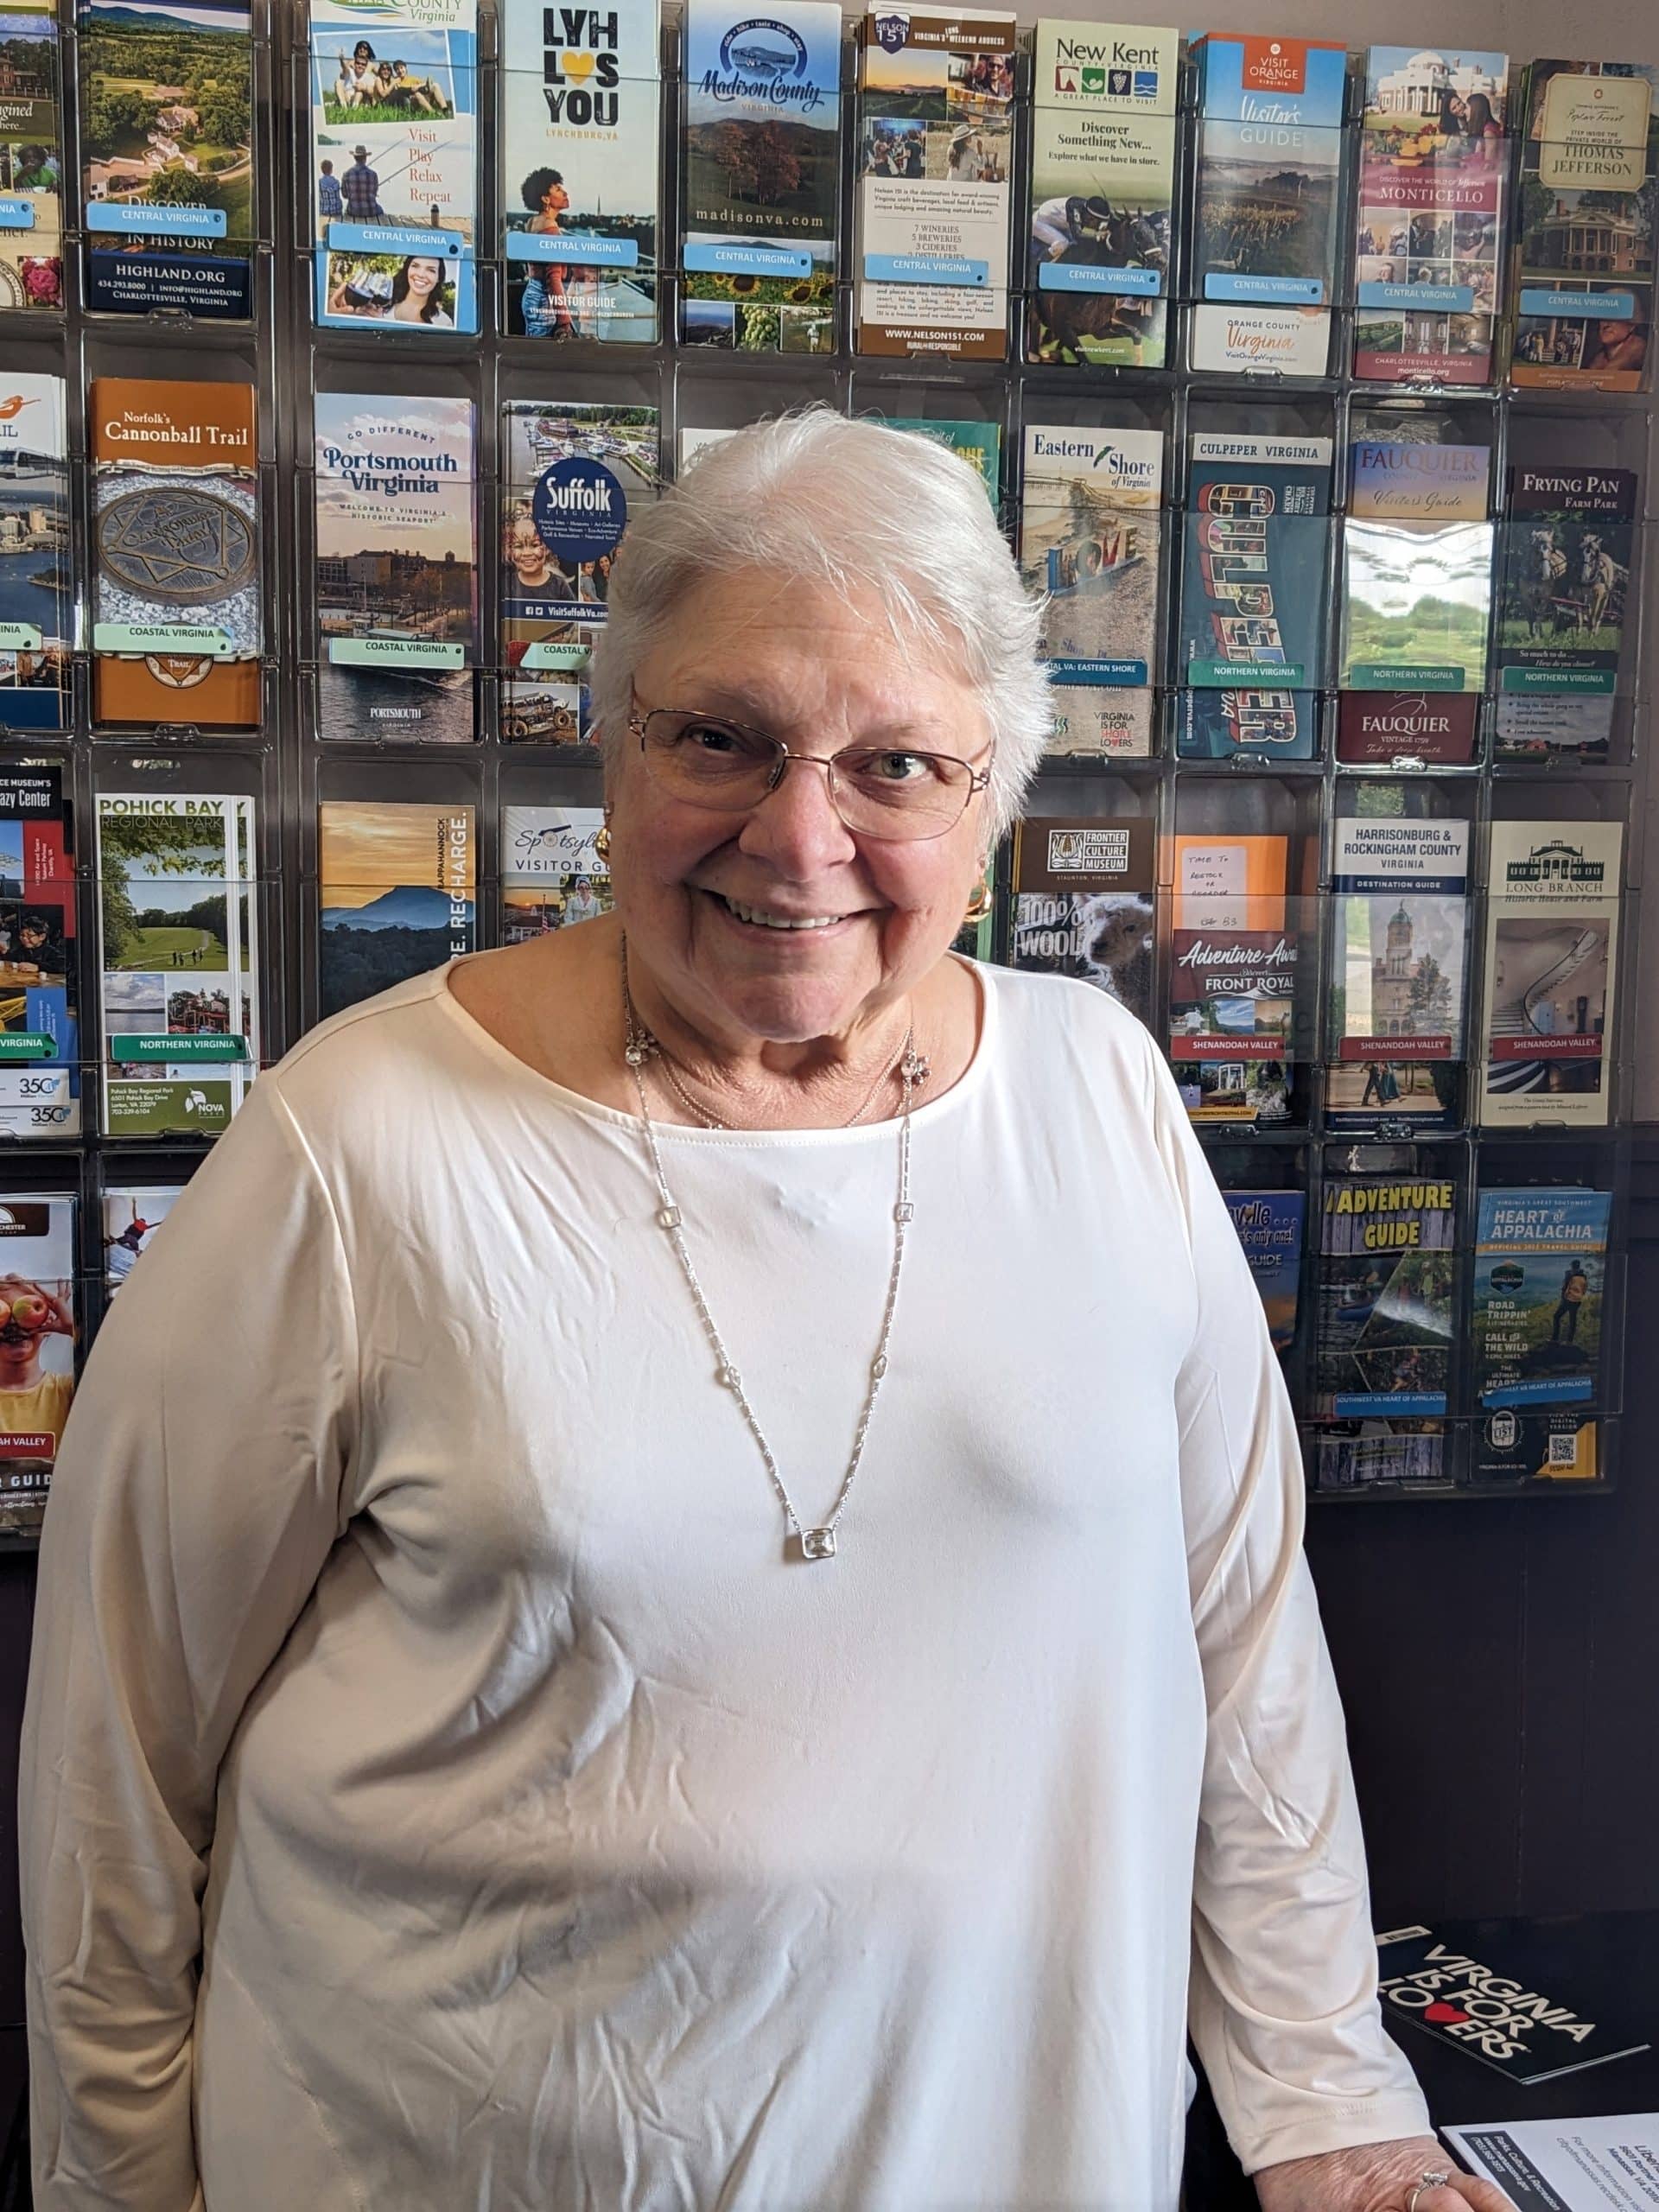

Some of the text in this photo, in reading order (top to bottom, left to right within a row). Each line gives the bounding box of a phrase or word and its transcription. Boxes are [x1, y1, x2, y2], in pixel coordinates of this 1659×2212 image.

[410, 9, 456, 24] Virginia
[543, 8, 618, 49] LYH
[876, 22, 909, 33] NELSON
[876, 30, 906, 42] 151
[1057, 38, 1160, 65] New Kent
[1260, 57, 1289, 68] VISIT
[1249, 66, 1299, 79] ORANGE
[698, 69, 825, 113] Madison County
[543, 89, 619, 126] YOU
[1240, 95, 1302, 125] Visitor's
[409, 128, 437, 143] Visit
[1081, 122, 1129, 135] Discover
[1058, 134, 1116, 149] Something
[1240, 128, 1302, 147] GUIDE
[409, 148, 435, 166] Play
[1048, 151, 1078, 162] Explore
[1079, 153, 1097, 162] what
[1110, 155, 1128, 164] have
[1562, 144, 1624, 160] THOMAS
[1552, 160, 1632, 175] JEFFERSON
[409, 168, 443, 183] Relax
[410, 188, 452, 206] Repeat
[1379, 187, 1484, 203] MONTICELLO
[122, 210, 210, 224] CENTRAL VIRGINIA
[696, 208, 824, 227] madisonva.com
[921, 225, 960, 234] WINERIES
[363, 231, 448, 245] CENTRAL VIRGINIA
[918, 234, 962, 244] BREWERIES
[539, 240, 621, 253] CENTRAL VIRGINIA
[715, 251, 796, 265] CENTRAL VIRGINIA
[893, 259, 971, 273] CENTRAL VIRGINIA
[116, 264, 226, 283] HIGHLAND.ORG
[1069, 270, 1146, 283] CENTRAL VIRGINIA
[1234, 280, 1308, 292] CENTRAL VIRGINIA
[1383, 287, 1458, 300] CENTRAL VIRGINIA
[548, 295, 616, 308] VISITOR GUIDE
[1548, 296, 1619, 308] CENTRAL VIRGINIA
[1227, 319, 1300, 331] ORANGE COUNTY
[885, 329, 985, 342] WWW.NELSON151.COM
[1226, 325, 1295, 355] Virginia
[1397, 366, 1450, 377] monticello.org
[124, 410, 171, 424] Norfolk's
[105, 421, 249, 446] Cannonball Trail
[347, 425, 435, 444] GO DIFFERENT
[1033, 434, 1155, 476] Eastern Shore
[1199, 442, 1319, 459] CULPEPER VIRGINIA
[323, 447, 458, 473] Portsmouth
[1361, 448, 1480, 474] FAUQUIER
[342, 469, 440, 497] Virginia
[1111, 476, 1152, 490] of Virginia
[1522, 474, 1619, 493] FRYING PAN
[546, 476, 612, 512] Suffolk
[1565, 497, 1618, 509] FARM PARK
[546, 509, 612, 518] VIRGINIA
[130, 626, 214, 639] COASTAL VIRGINIA
[365, 641, 448, 654] COASTAL VIRGINIA
[543, 645, 582, 654] COASTAL
[1077, 664, 1137, 673] EASTERN SHORE
[1213, 666, 1296, 677] NORTHERN VIRGINIA
[1373, 670, 1454, 680] NORTHERN VIRGINIA
[1525, 672, 1604, 683] NORTHERN VIRGINIA
[370, 707, 422, 719] PORTSMOUTH
[1094, 711, 1135, 721] VIRGINIA
[1101, 721, 1128, 729] IS FOR
[1362, 715, 1451, 735] FAUQUIER
[10, 779, 52, 787] MUSEUM'S
[19, 789, 52, 807] Center
[99, 799, 225, 815] POHICK BAY
[101, 815, 223, 830] REGIONAL PARK
[1086, 833, 1126, 843] FRONTIER
[1355, 829, 1452, 842] HARRISONBURG &
[436, 817, 446, 889] RAPPAHANNOCK
[1085, 846, 1125, 856] CULTURE
[1344, 843, 1462, 857] ROCKINGHAM COUNTY
[450, 811, 467, 930] RECHARGE.
[515, 859, 582, 873] VISITOR
[1085, 859, 1124, 869] MUSEUM
[1381, 859, 1425, 869] VIRGINIA
[1356, 880, 1441, 889] DESTINATION GUIDE
[1506, 882, 1603, 893] LONG BRANCH
[1020, 899, 1083, 927] 100%
[1020, 930, 1081, 957] WOOL
[1178, 939, 1266, 969] Adventure
[1205, 976, 1294, 991] FRONT ROYAL
[0, 1039, 43, 1047] VIRGINIA
[139, 1039, 235, 1049] NORTHERN VIRGINIA
[1360, 1040, 1445, 1050] SHENANDOAH VALLEY
[1513, 1039, 1596, 1050] SHENANDOAH VALLEY
[198, 1103, 225, 1113] NOVA
[1337, 1184, 1454, 1214] ADVENTURE
[1494, 1210, 1549, 1224] HEART
[1363, 1221, 1421, 1249] GUIDE
[1491, 1224, 1592, 1238] APPALACHIA
[1488, 1300, 1515, 1309] ROAD
[1486, 1310, 1531, 1319] TRIPPIN'
[1485, 1333, 1507, 1342] CALL
[1484, 1343, 1529, 1351] THE WILD
[13, 1437, 47, 1446] VALLEY
[10, 1474, 53, 1487] GUID
[1424, 1943, 1597, 2044] VIRGINIA
[1406, 1968, 1535, 2038] IS FOR
